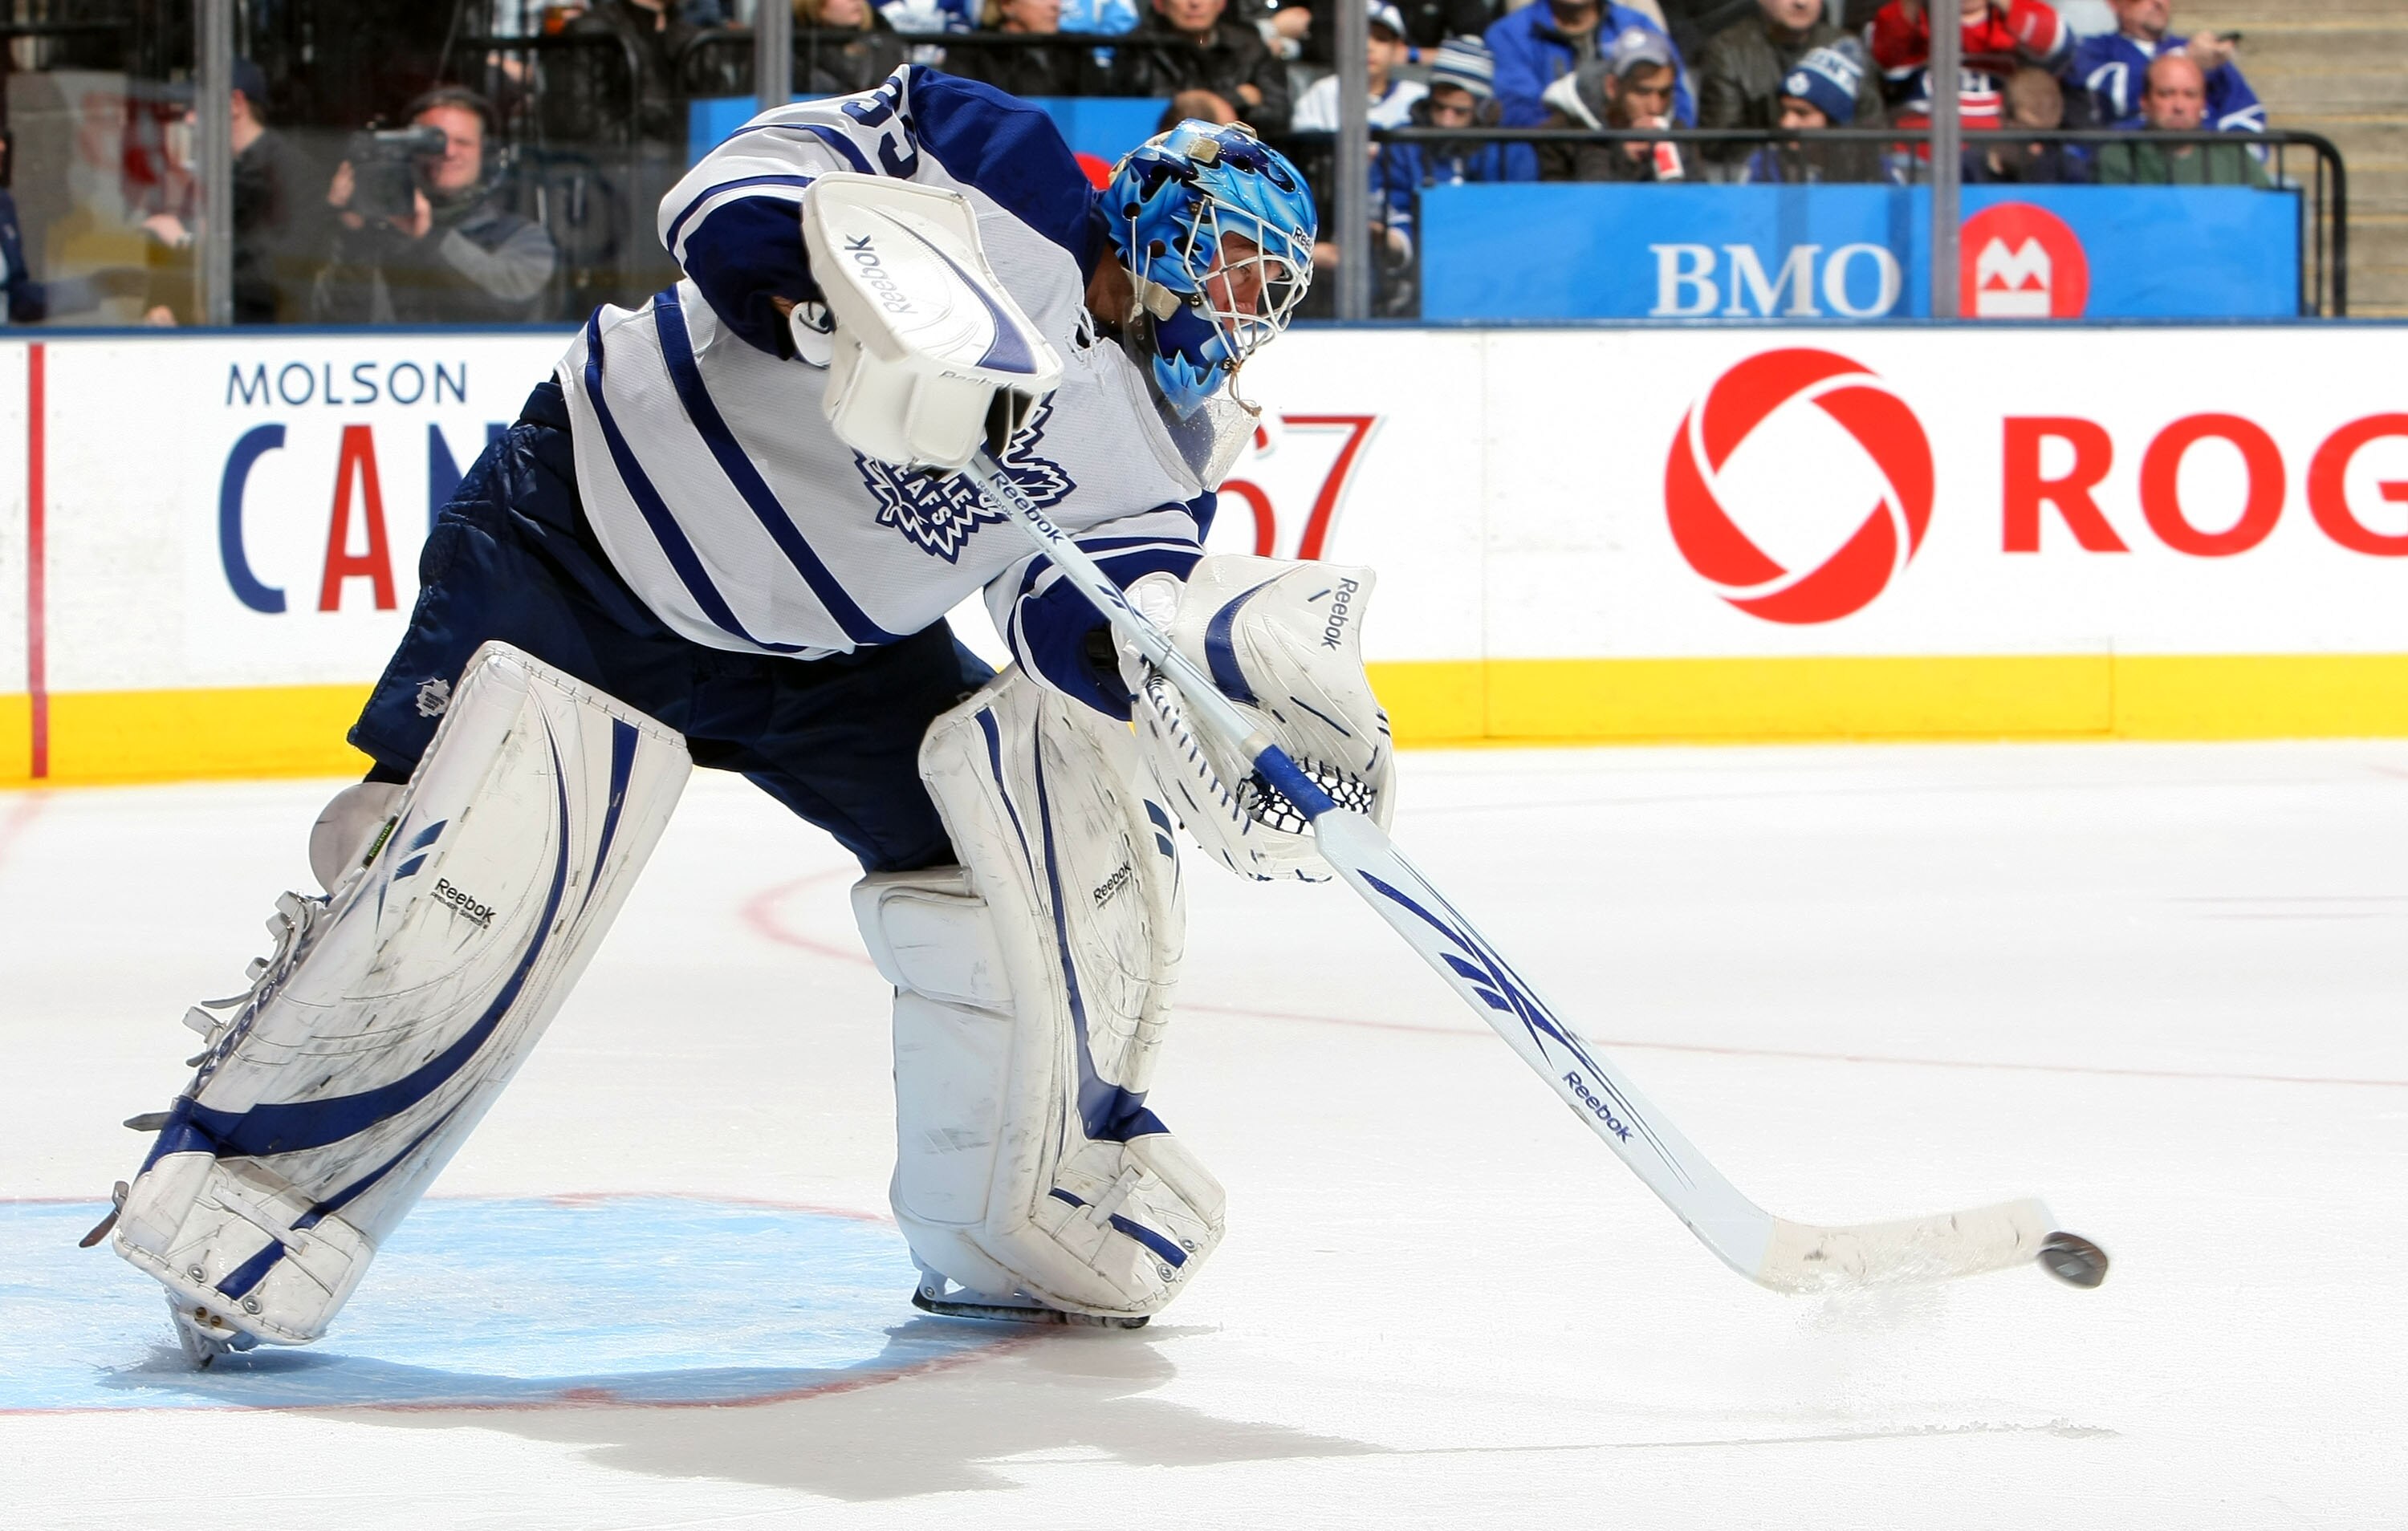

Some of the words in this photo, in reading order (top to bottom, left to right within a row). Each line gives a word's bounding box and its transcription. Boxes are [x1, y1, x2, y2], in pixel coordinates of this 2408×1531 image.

[840, 76, 919, 179] 35
[844, 234, 918, 314] Reebok
[1649, 242, 1901, 318] BMO
[226, 362, 467, 405] MOLSON
[889, 463, 953, 526] EAFS
[977, 480, 1014, 518] Reebok
[988, 471, 1067, 546] Reebok
[2002, 412, 2408, 558] ROG
[1320, 577, 1359, 652] Reebok
[434, 878, 497, 924] Reebok
[1092, 860, 1131, 904] Reebok
[1562, 1070, 1634, 1144] Reebok
